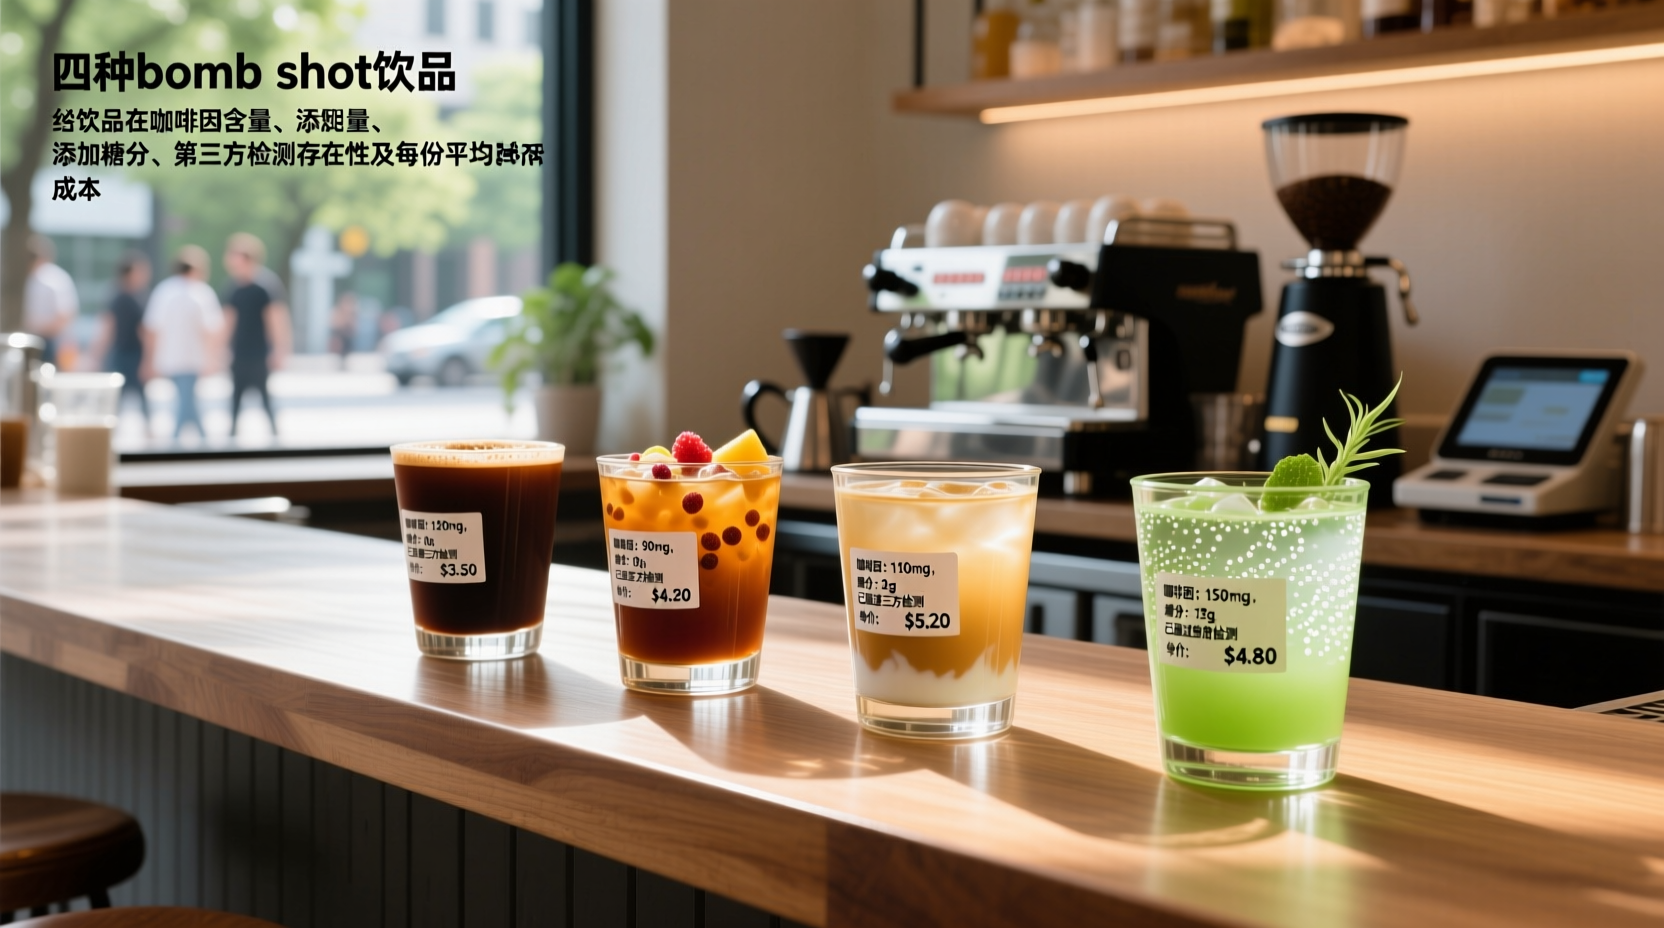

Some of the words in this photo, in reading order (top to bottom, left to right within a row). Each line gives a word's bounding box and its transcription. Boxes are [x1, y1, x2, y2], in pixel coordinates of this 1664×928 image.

[440, 563, 477, 578] $3.50
[651, 587, 691, 604] $4.20
[904, 611, 951, 631] $5.20
[1223, 645, 1277, 667] $4.80
